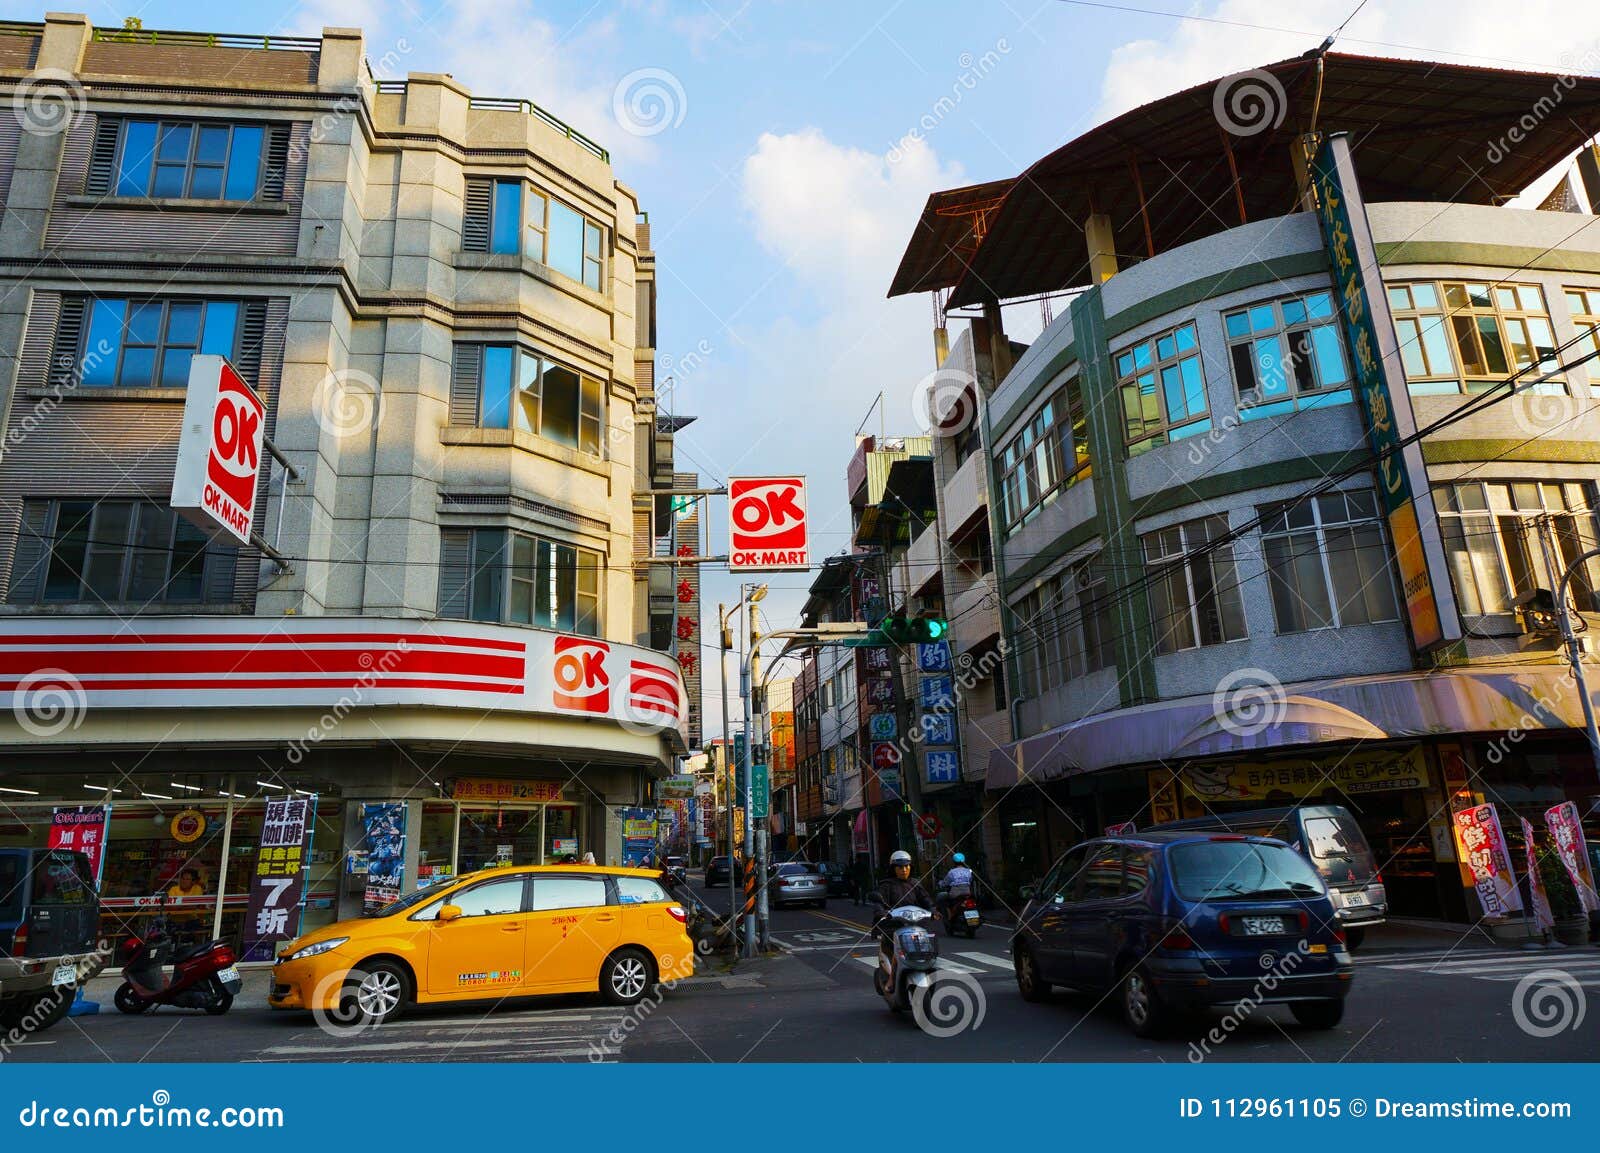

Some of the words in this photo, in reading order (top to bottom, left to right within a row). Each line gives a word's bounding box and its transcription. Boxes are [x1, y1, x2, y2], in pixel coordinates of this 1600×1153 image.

[213, 397, 259, 470] OK
[732, 486, 805, 533] OK
[553, 650, 610, 692] OK
[263, 824, 302, 844] 咖啡
[260, 878, 294, 907] 7
[256, 908, 288, 934] 折
